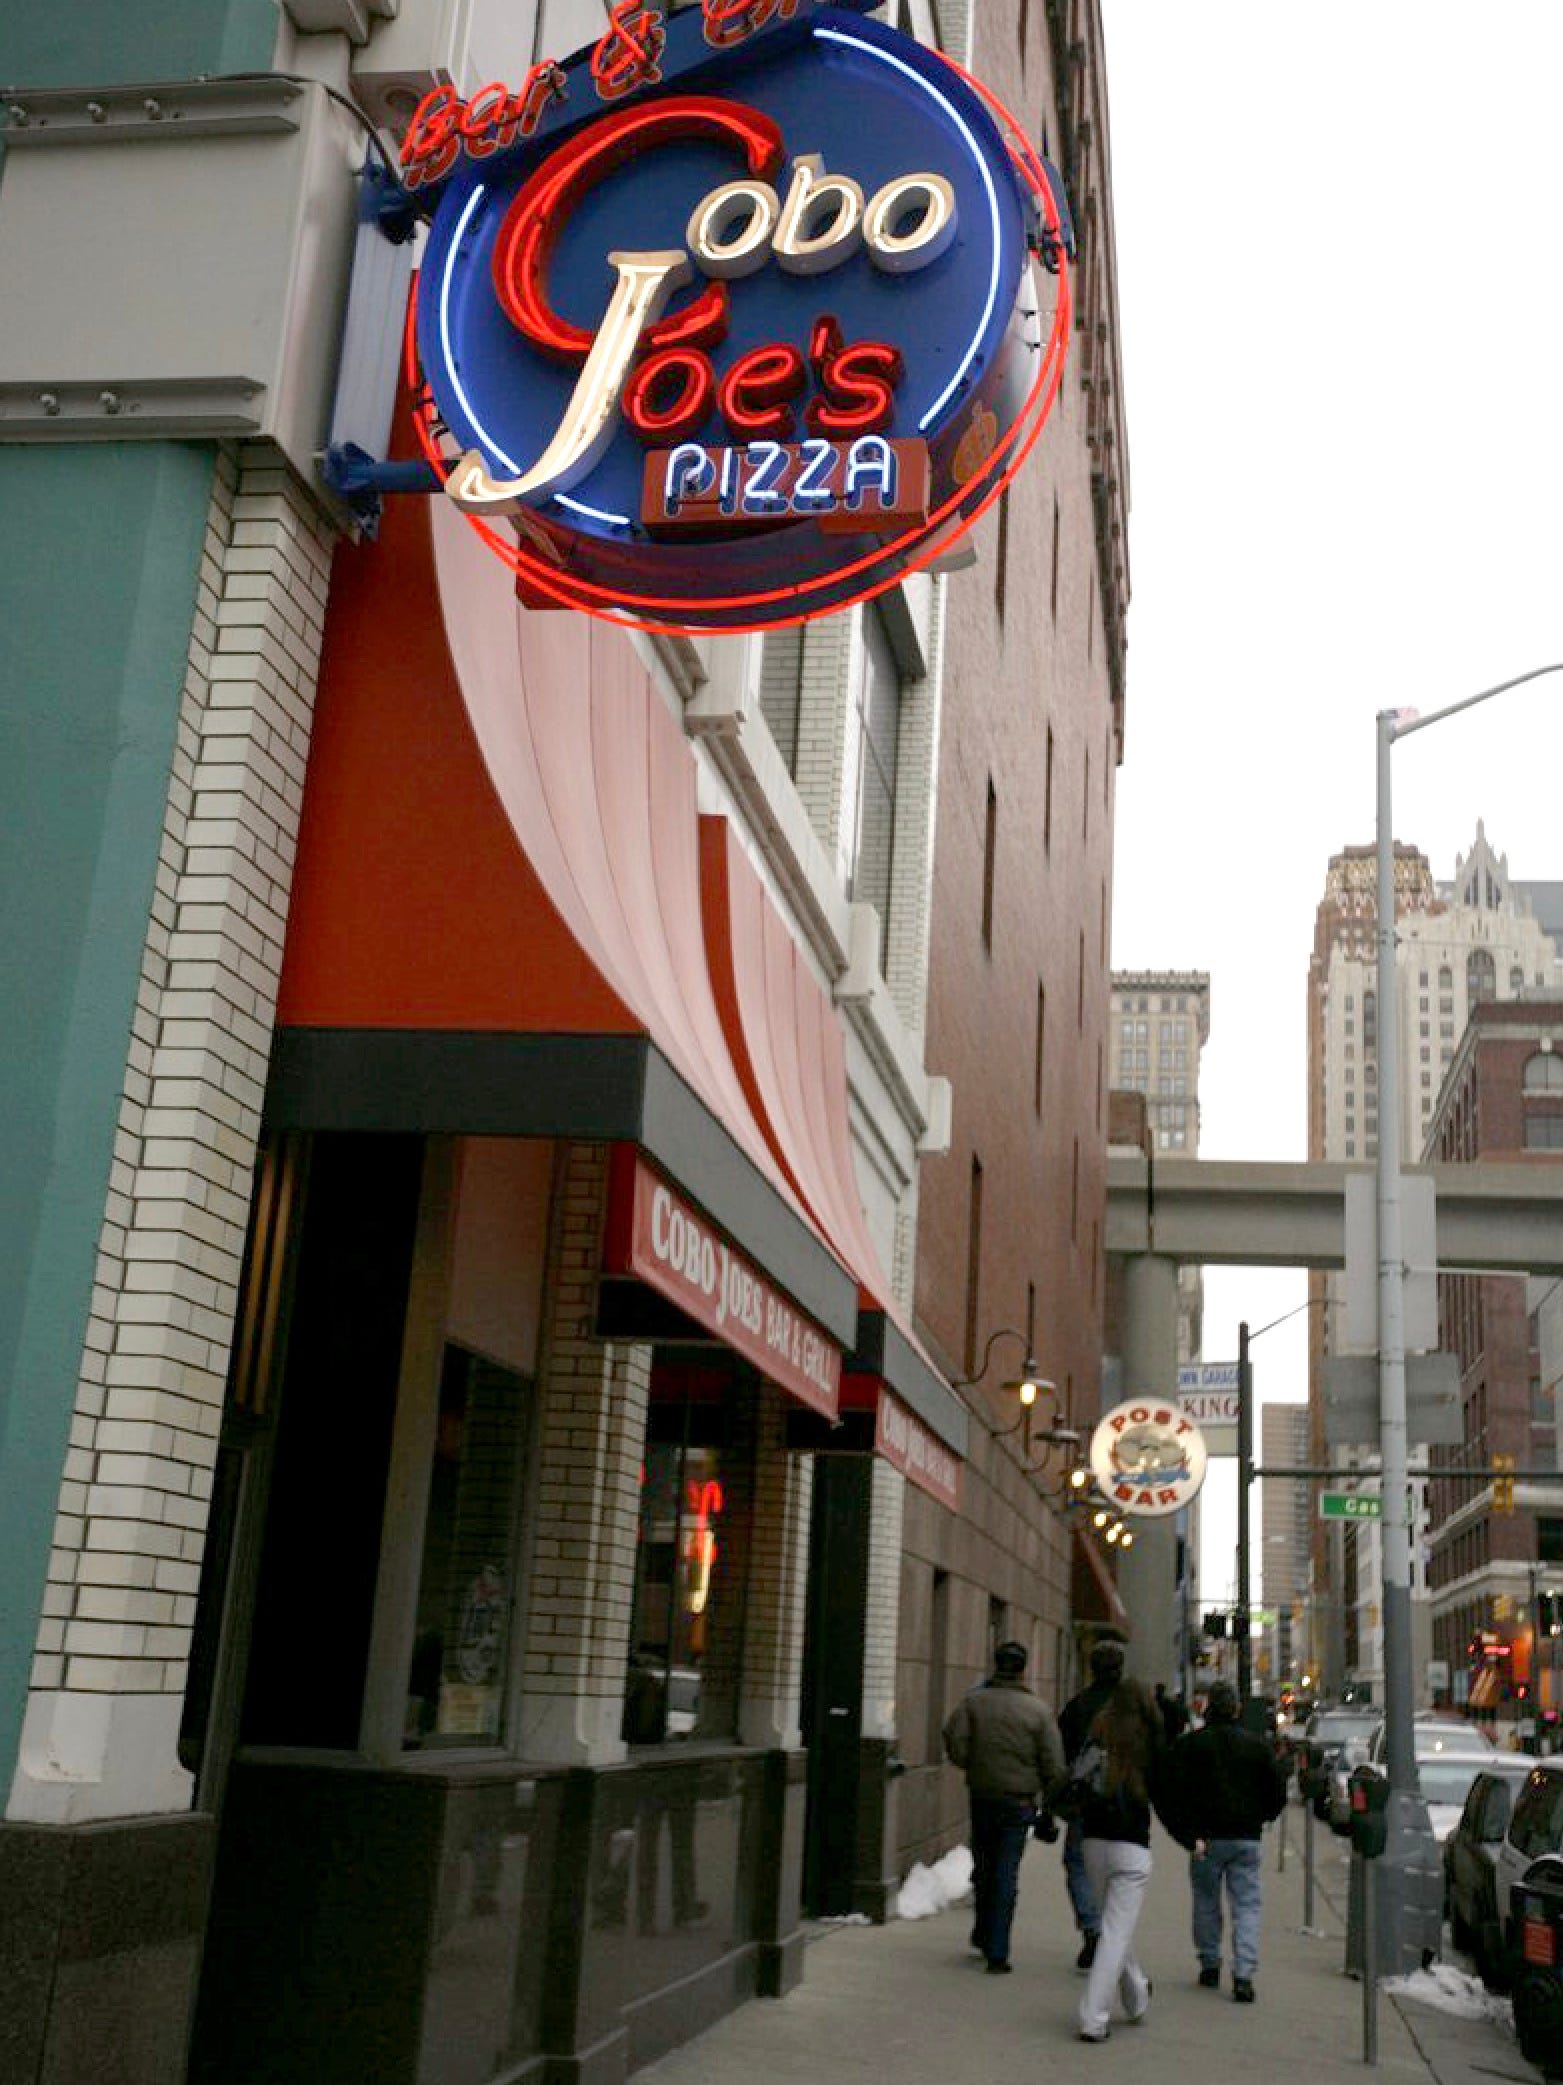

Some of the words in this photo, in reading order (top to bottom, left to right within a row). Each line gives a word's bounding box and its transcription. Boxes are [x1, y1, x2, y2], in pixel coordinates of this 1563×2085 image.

[400, 59, 566, 190] Bar
[492, 95, 957, 359] Cobo
[446, 250, 904, 516] Joe's
[661, 434, 896, 517] PIZZA
[1110, 1407, 1193, 1434] POST
[1115, 1484, 1177, 1506] BAR
